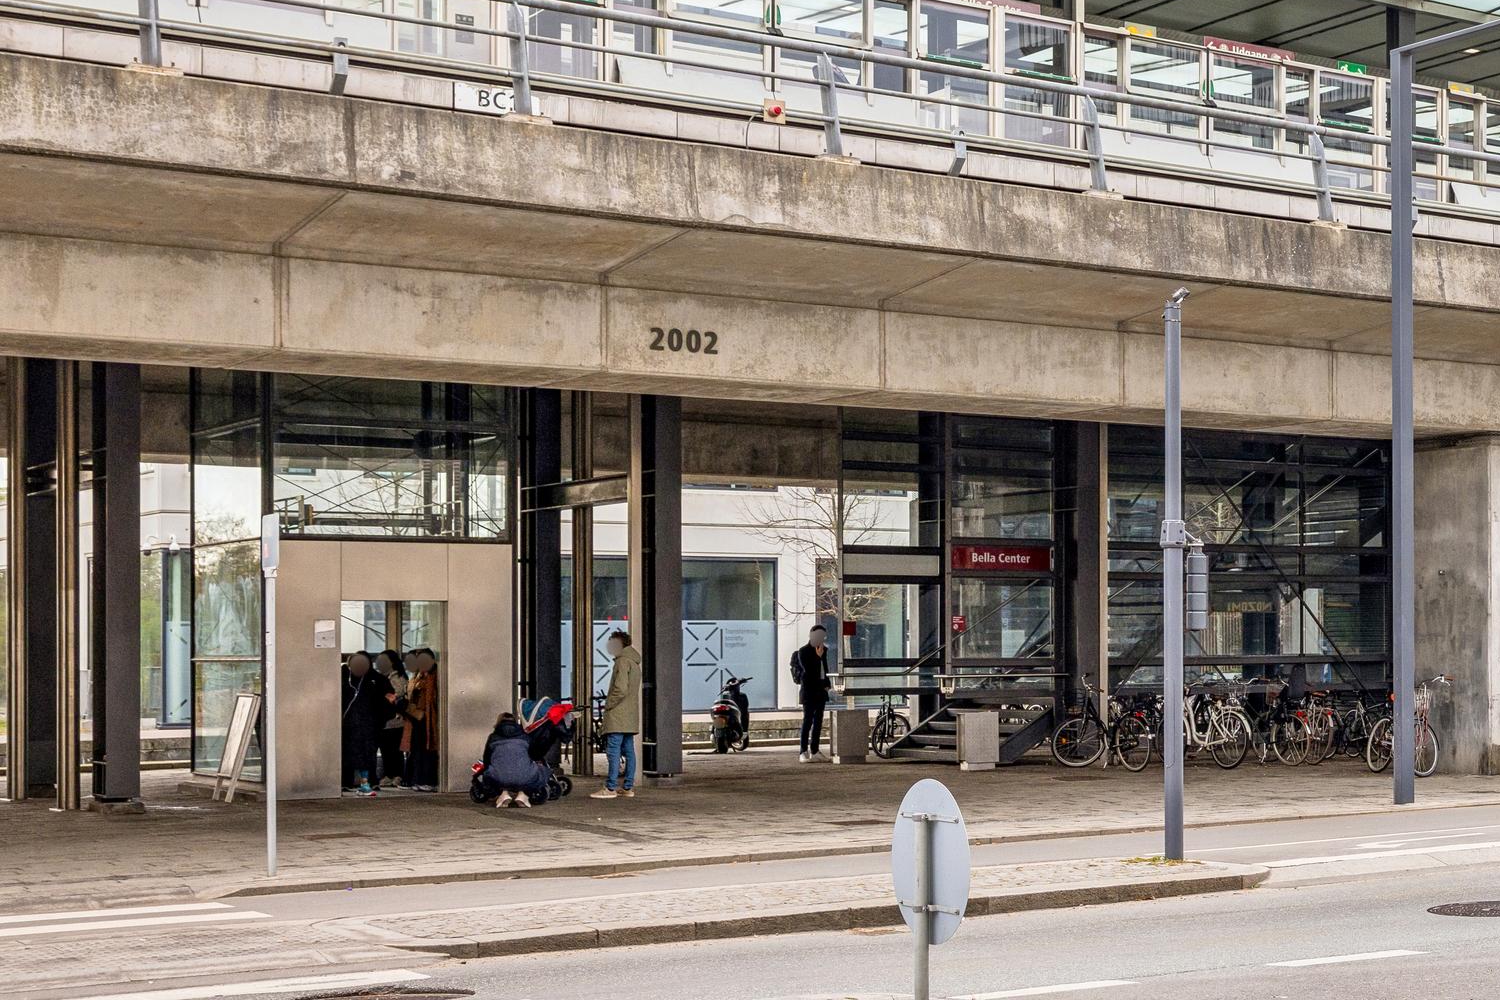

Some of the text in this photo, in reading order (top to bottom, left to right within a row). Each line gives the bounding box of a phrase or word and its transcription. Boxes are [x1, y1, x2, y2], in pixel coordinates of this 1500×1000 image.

[649, 327, 719, 355] 2002
[971, 552, 1031, 564] Bella Center
